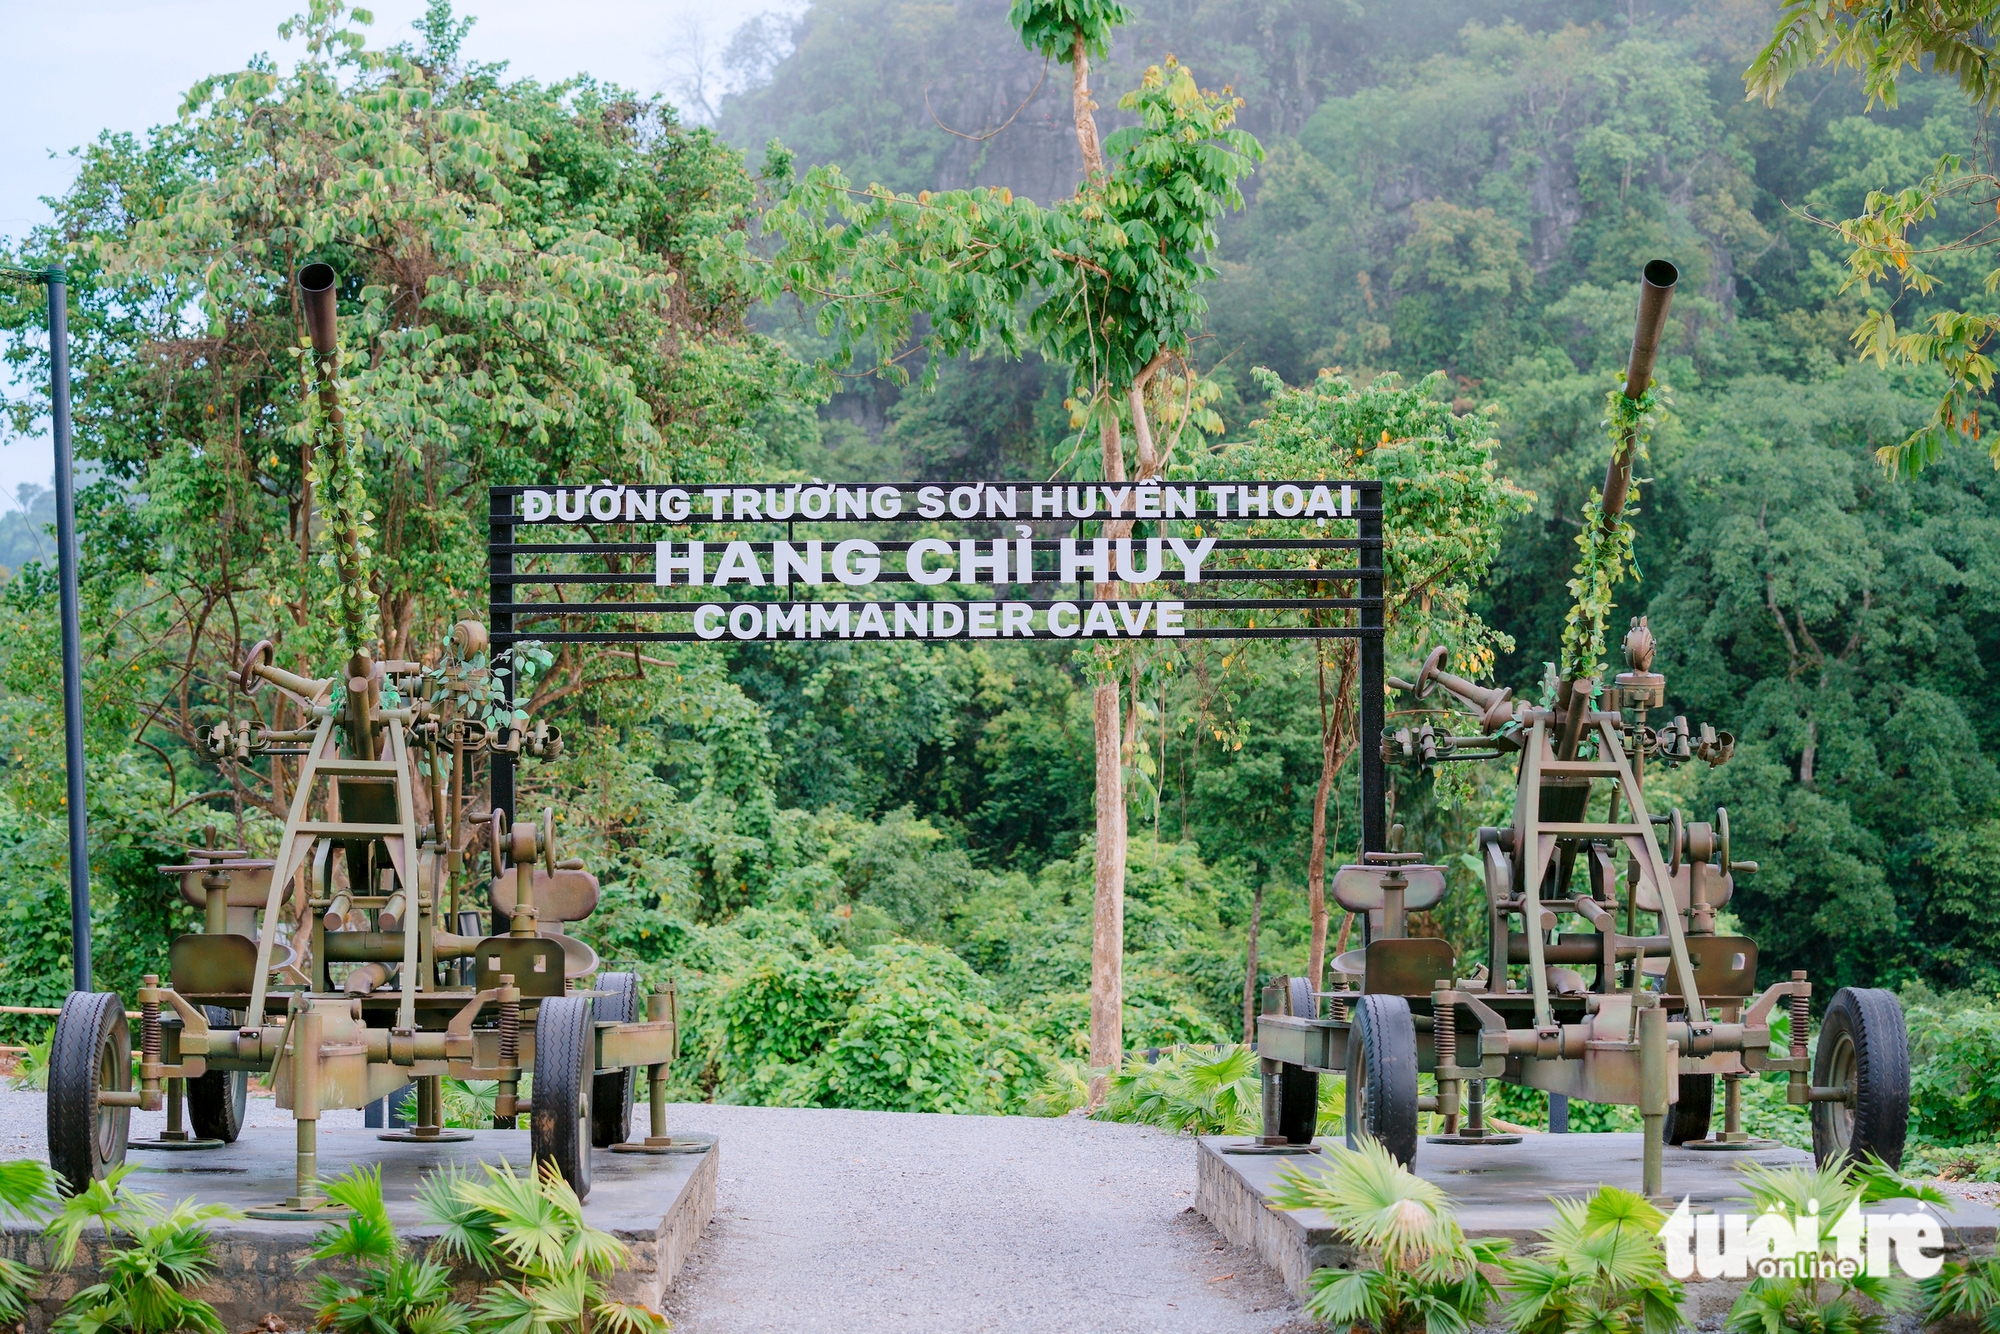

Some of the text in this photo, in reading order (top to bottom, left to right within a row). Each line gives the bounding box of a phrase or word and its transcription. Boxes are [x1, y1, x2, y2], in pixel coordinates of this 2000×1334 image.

[521, 475, 1353, 527] ĐƯỜNG TRƯỜNG SƠN HUYỀN THOẠI
[655, 525, 1217, 587] HANG CHỈ HUY
[693, 601, 1185, 640] COMMANDER CAVE
